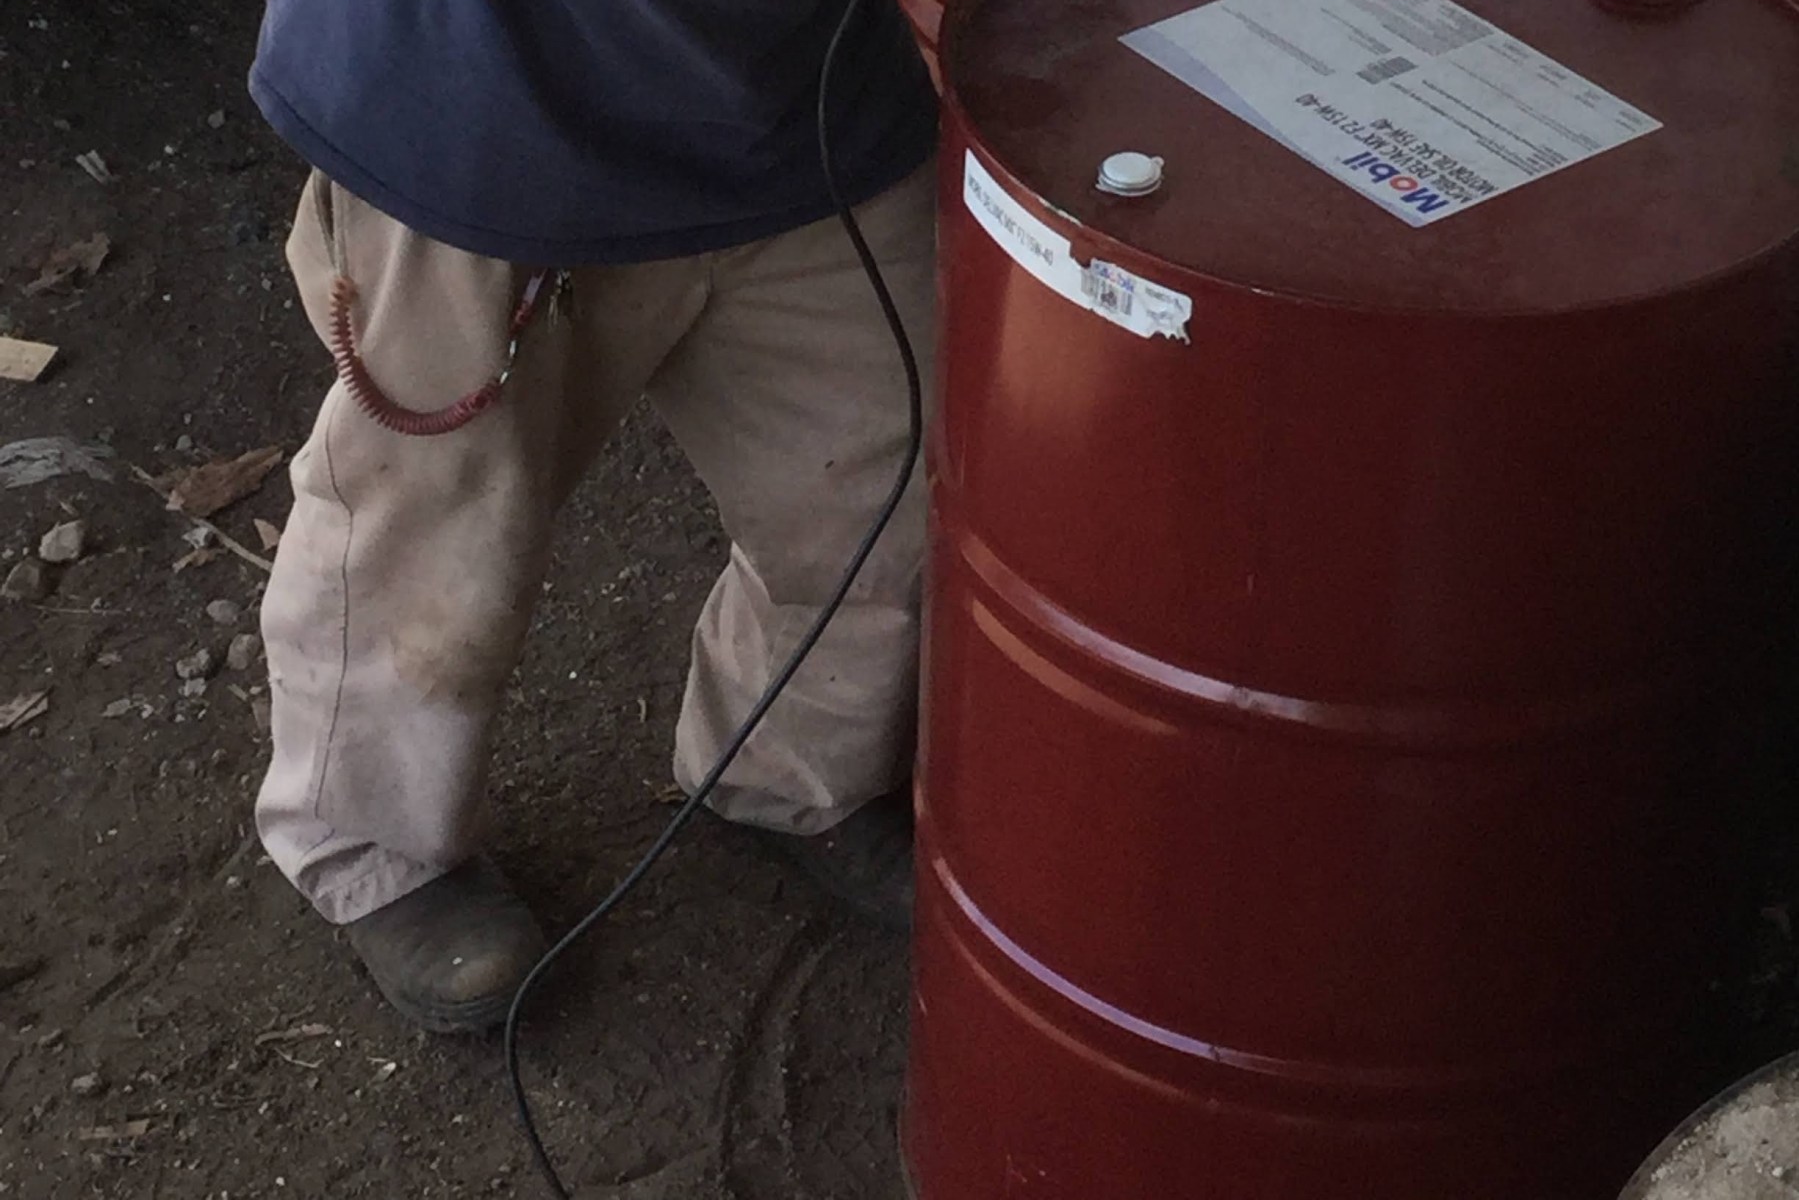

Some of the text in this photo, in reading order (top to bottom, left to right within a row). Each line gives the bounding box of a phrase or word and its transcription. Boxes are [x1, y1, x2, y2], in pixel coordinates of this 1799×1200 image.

[1295, 93, 1348, 126] 15W-40
[1370, 117, 1419, 148] 15W-40
[1379, 144, 1437, 180] DELVAC
[1342, 152, 1450, 213] Mobil
[1430, 174, 1475, 204] MOBIL
